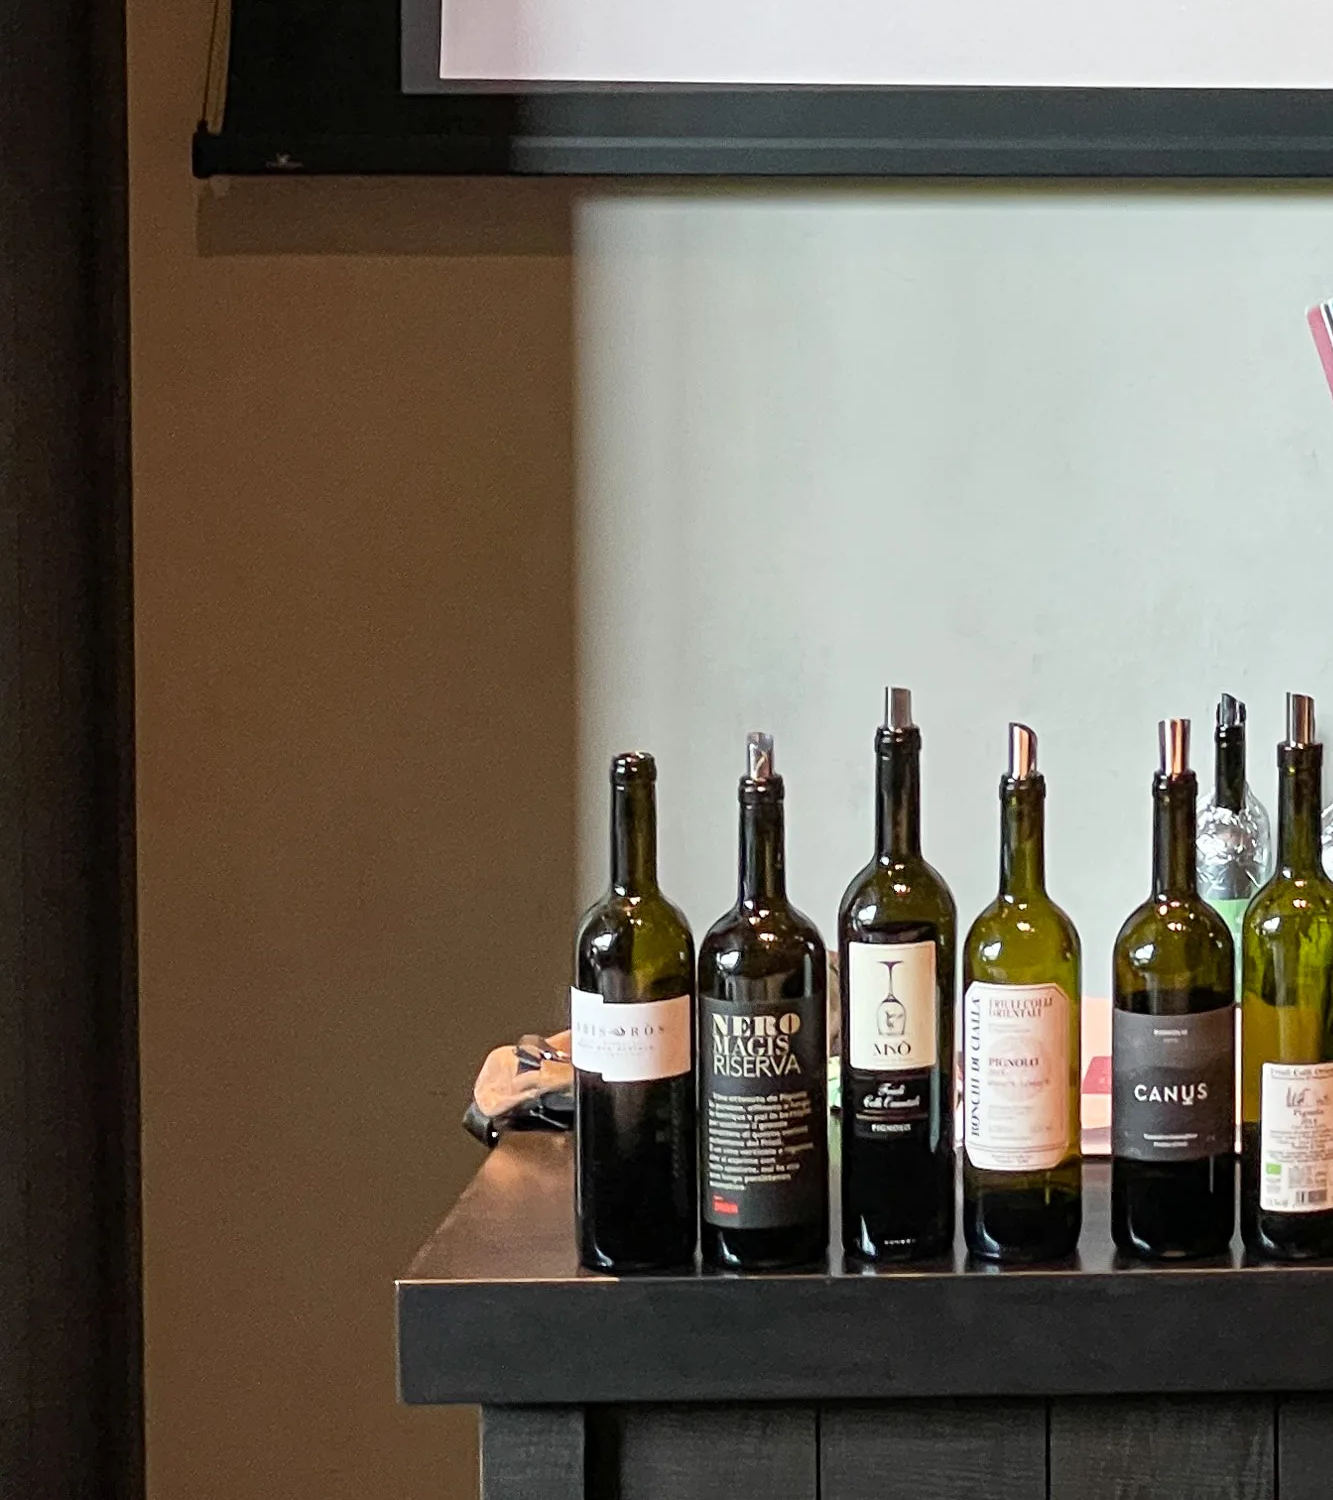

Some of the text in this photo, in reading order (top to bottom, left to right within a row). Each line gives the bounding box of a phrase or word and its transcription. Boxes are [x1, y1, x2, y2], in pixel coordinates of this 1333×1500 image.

[712, 1013, 801, 1037] NERO
[712, 1034, 789, 1056] MAGIS
[713, 1053, 801, 1077] RISERVA
[1133, 1082, 1209, 1106] CANUS
